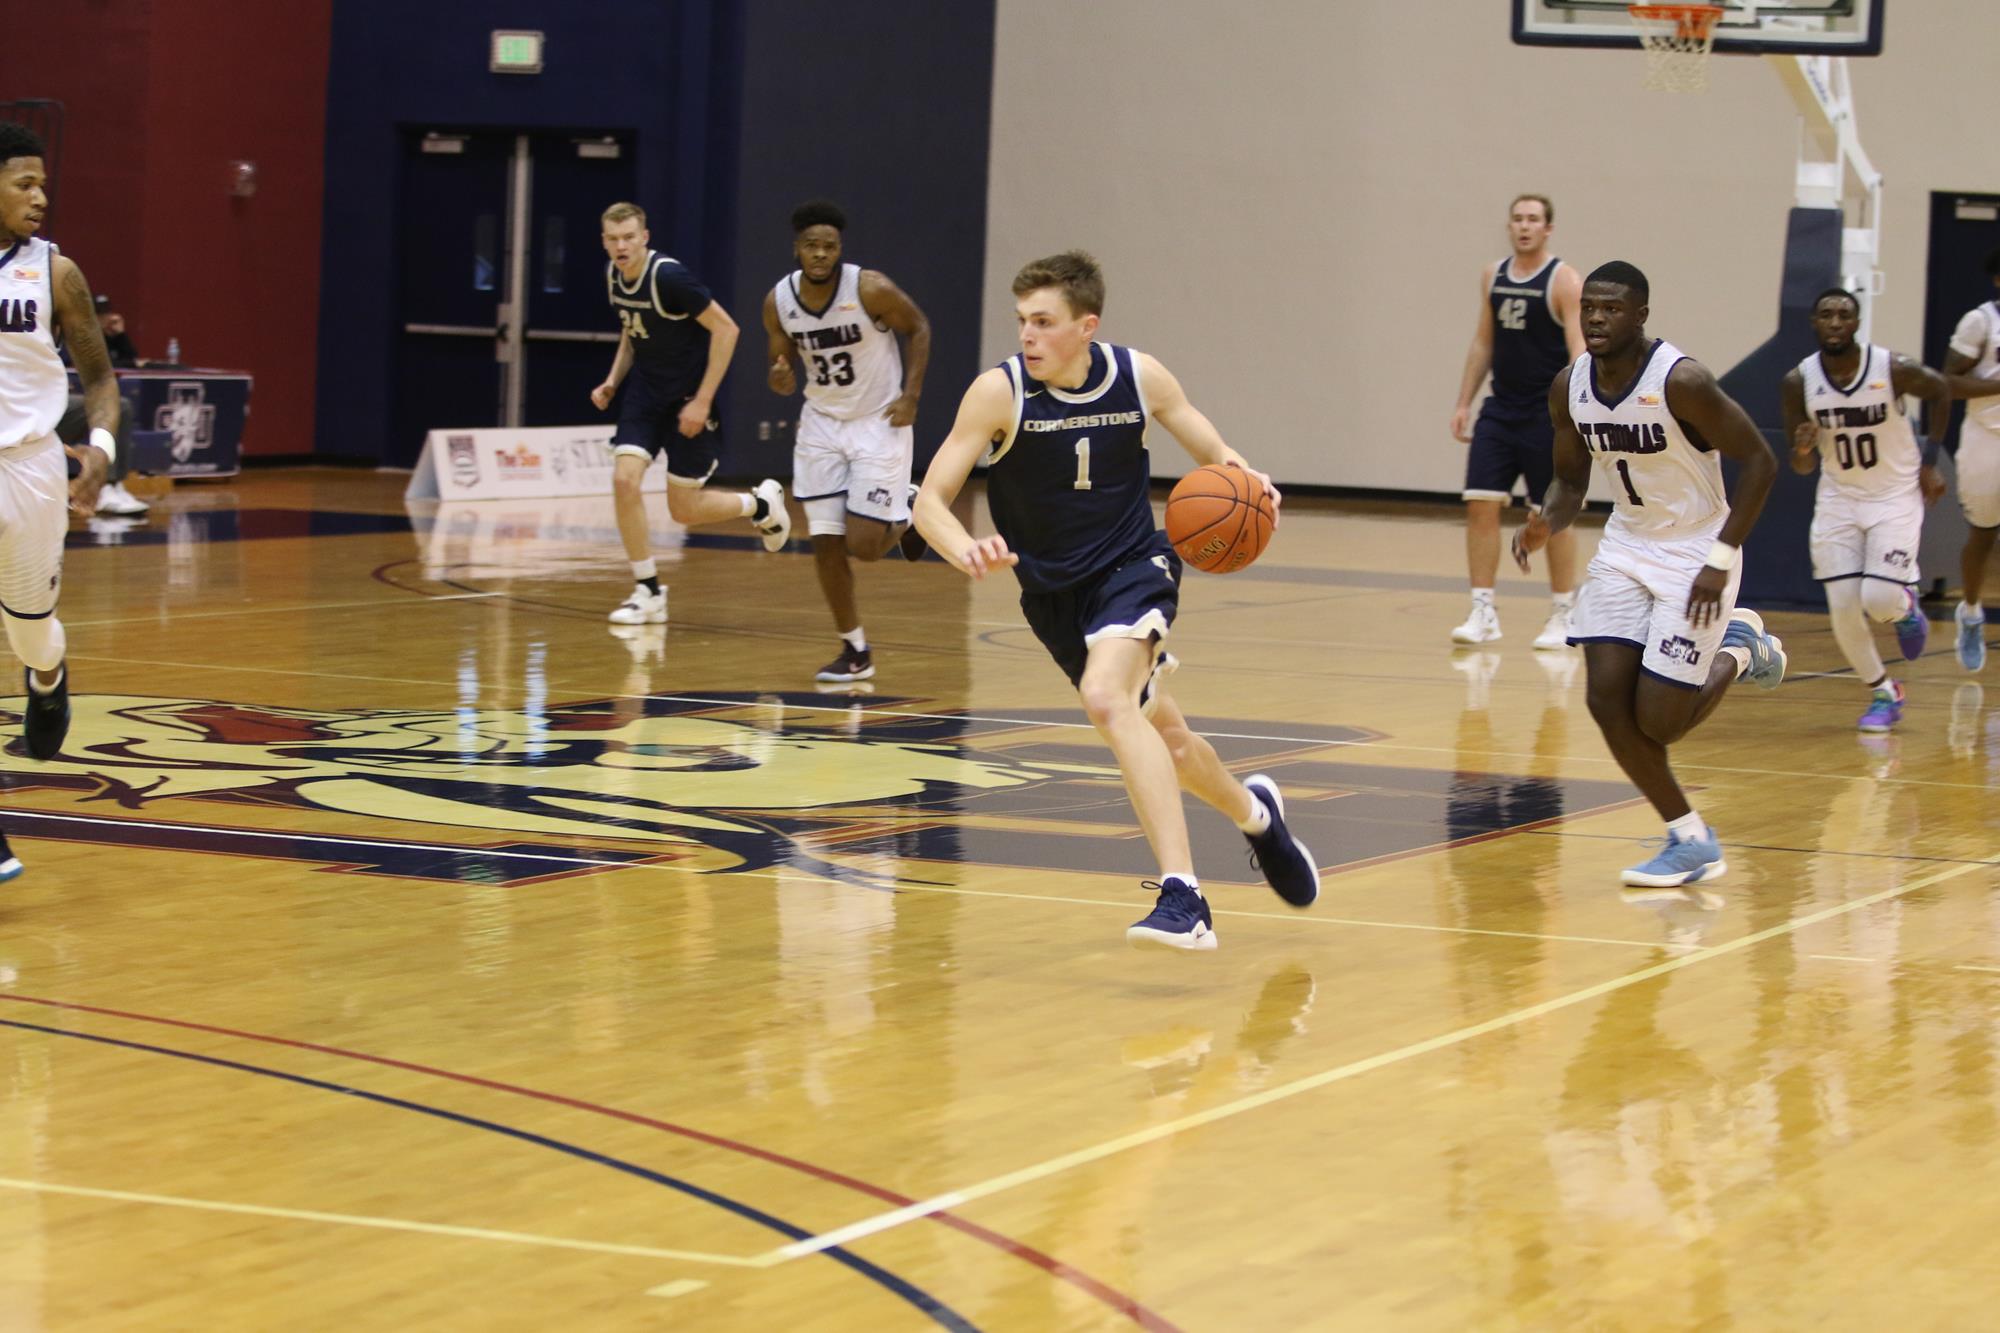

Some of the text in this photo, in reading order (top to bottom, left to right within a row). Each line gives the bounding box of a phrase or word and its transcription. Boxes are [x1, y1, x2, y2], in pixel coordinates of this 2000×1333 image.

[619, 310, 649, 339] 24
[1498, 298, 1528, 330] 42
[812, 352, 855, 387] 33
[1023, 411, 1141, 432] CORNERSTONE
[1578, 423, 1667, 454] T THOMAS
[1834, 433, 1878, 470] 00
[1073, 437, 1092, 490] 1
[1616, 459, 1644, 506] 1
